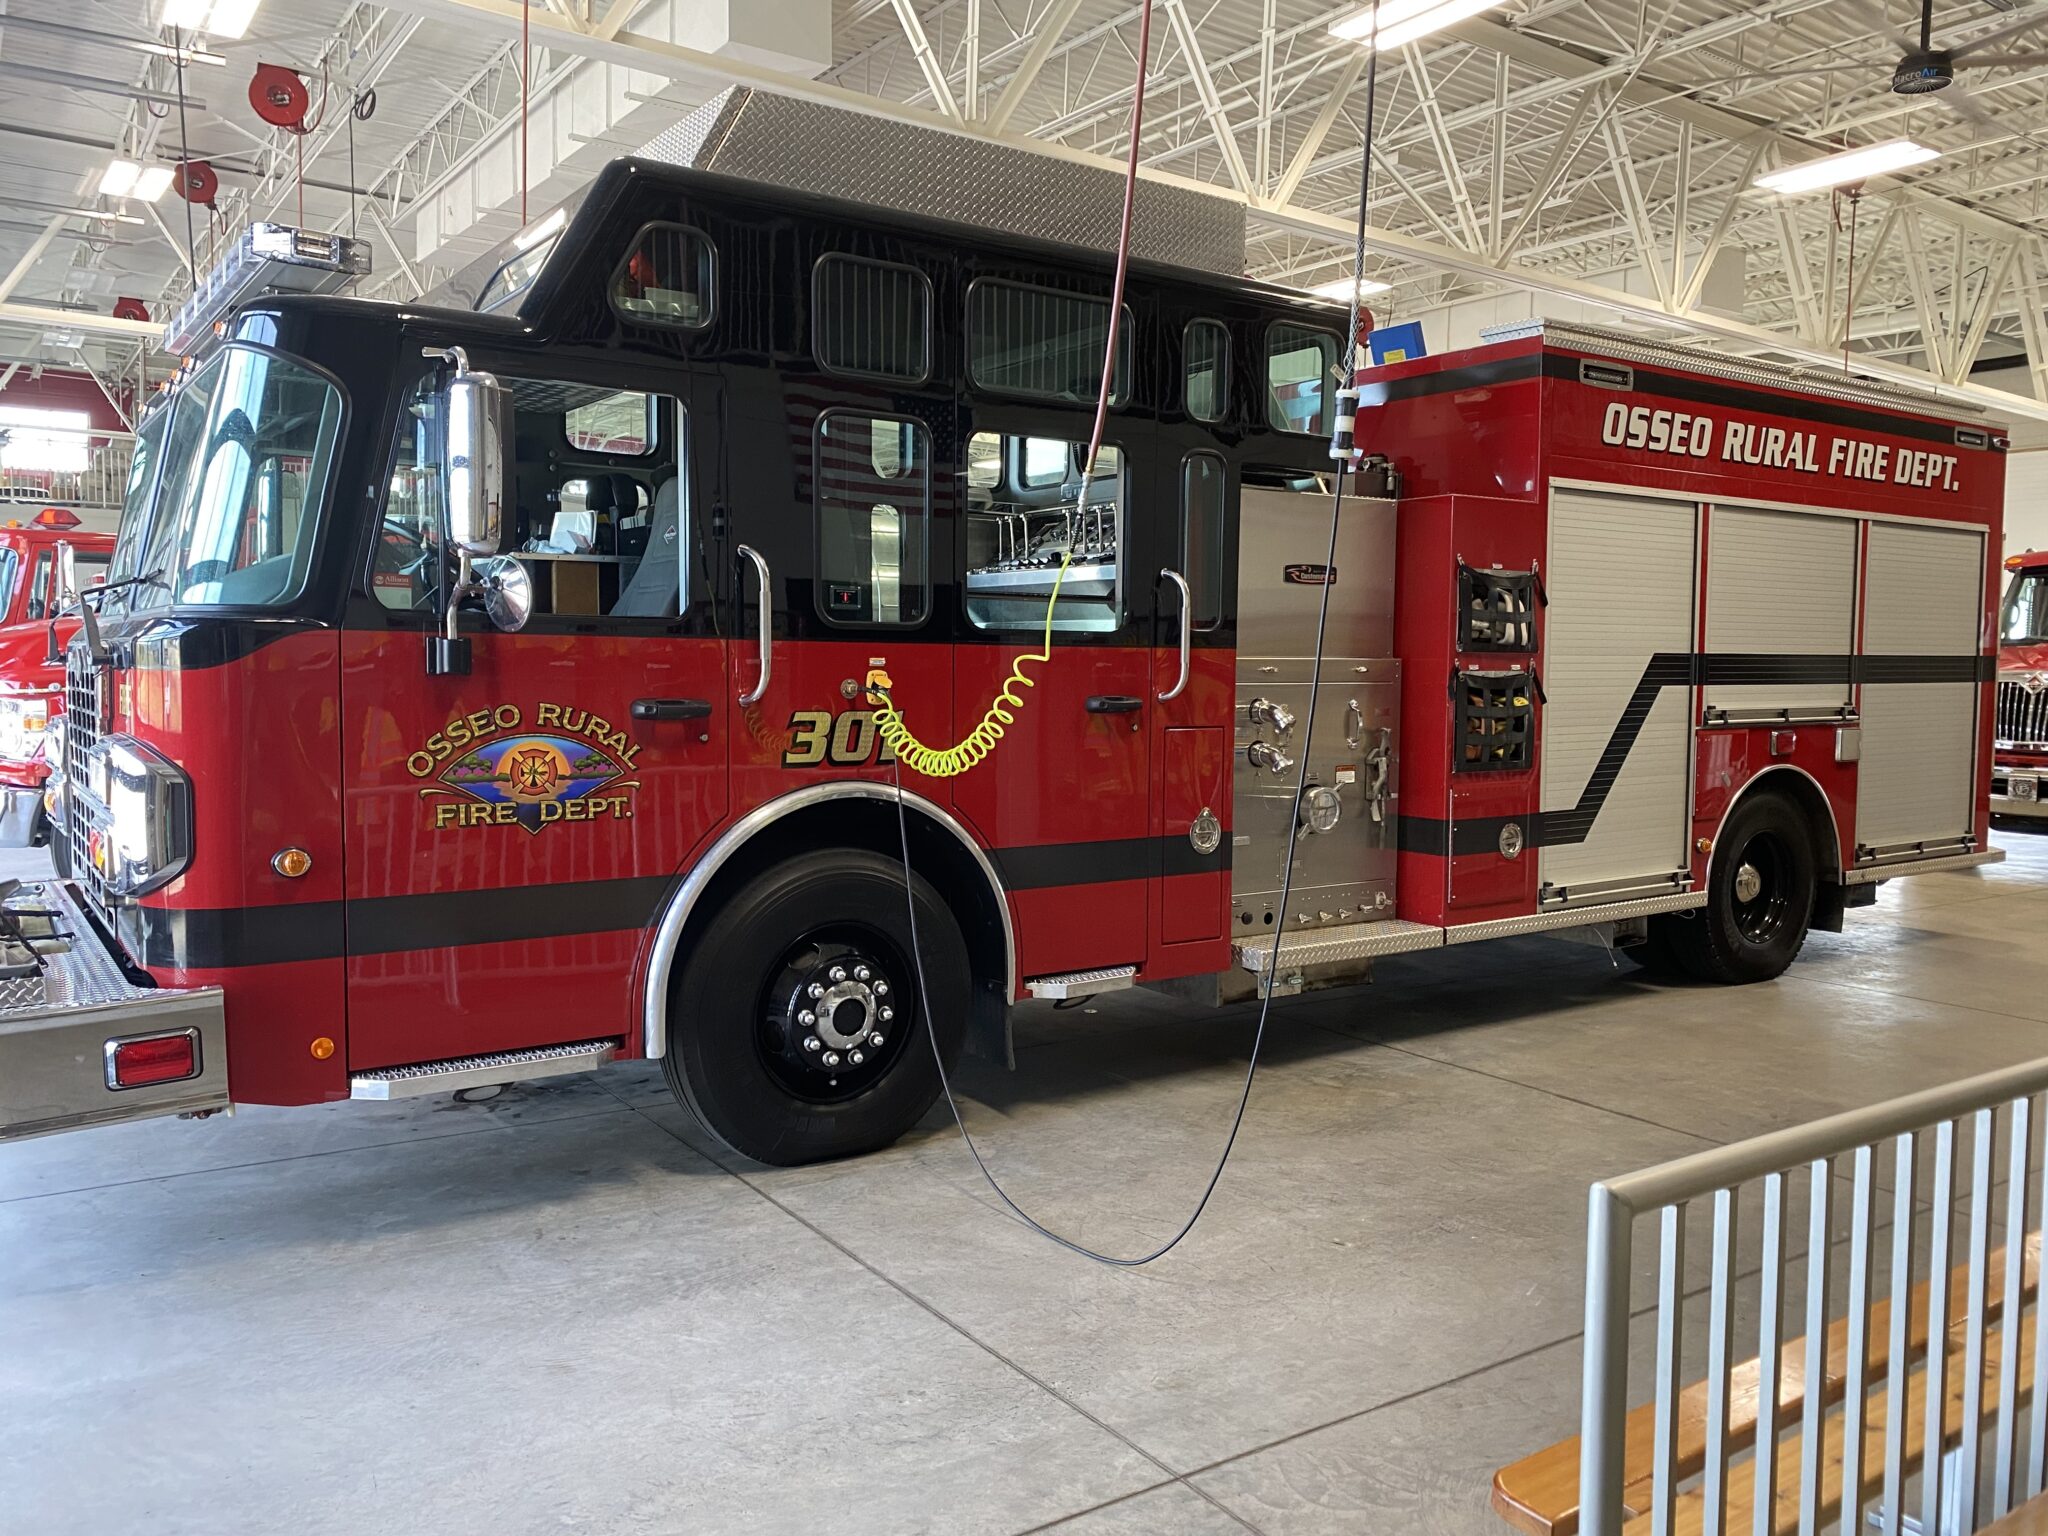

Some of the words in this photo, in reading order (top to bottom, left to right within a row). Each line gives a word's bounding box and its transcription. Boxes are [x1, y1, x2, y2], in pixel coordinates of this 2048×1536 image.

[1602, 402, 1713, 457] OSSEO
[1721, 421, 1820, 473] RURAL
[1827, 438, 1891, 482] FIRE
[1894, 448, 1960, 491] DEPT.
[407, 703, 521, 778] OSSEO
[536, 702, 643, 771] RURAL
[435, 801, 518, 828] FIRE
[540, 797, 634, 822] DEPT.
